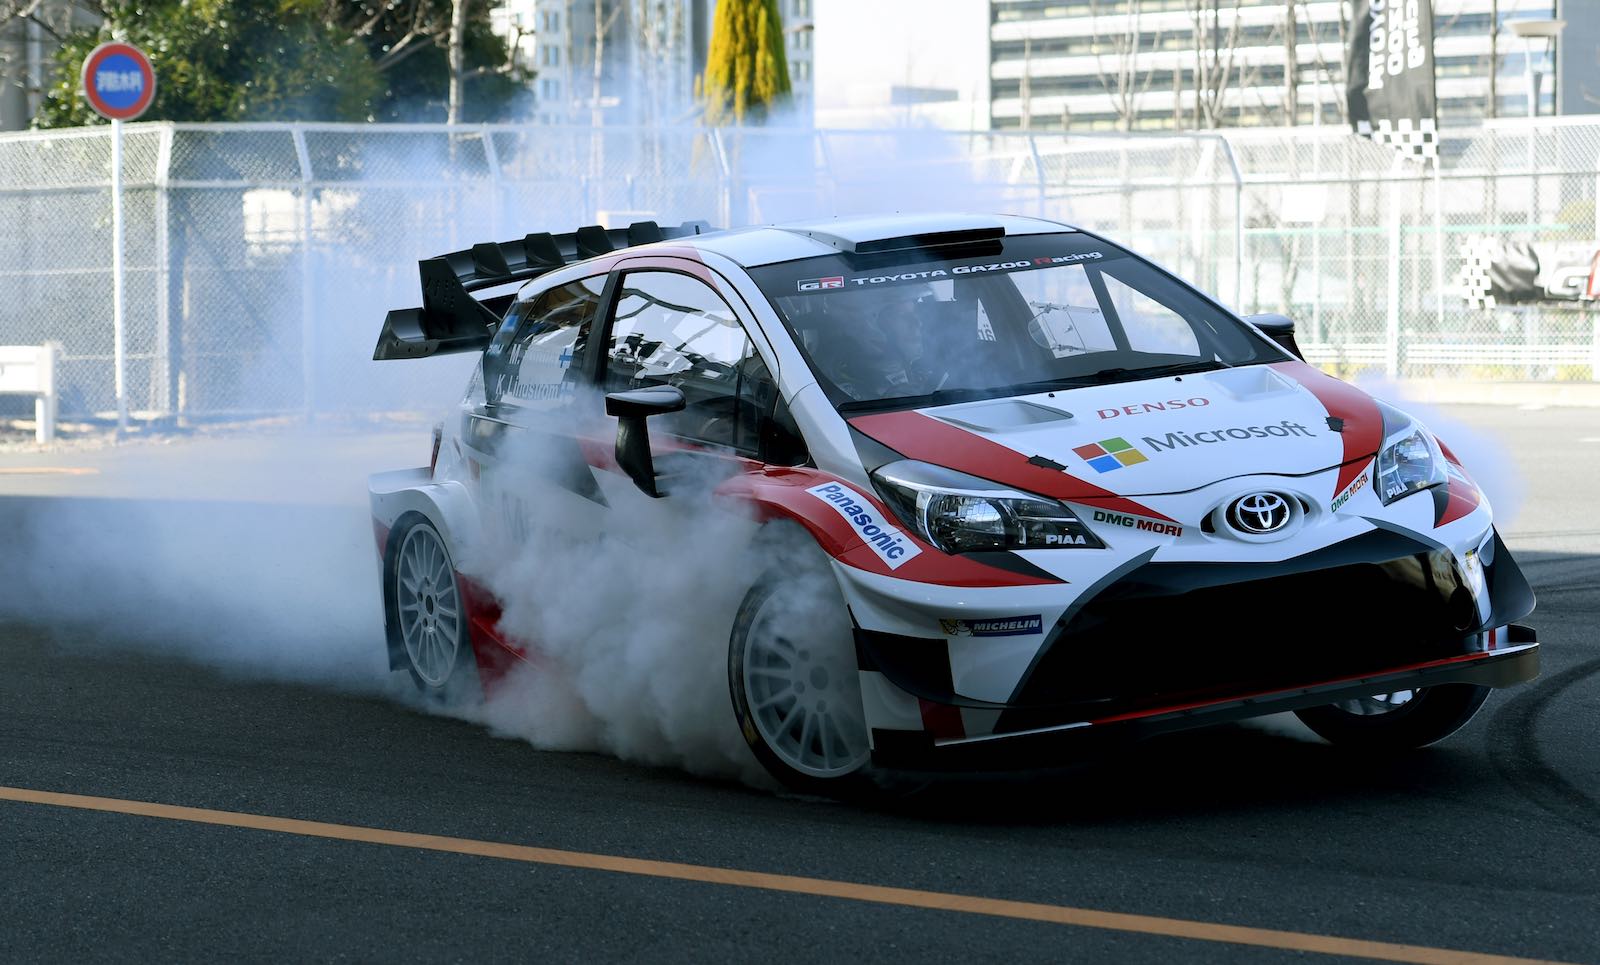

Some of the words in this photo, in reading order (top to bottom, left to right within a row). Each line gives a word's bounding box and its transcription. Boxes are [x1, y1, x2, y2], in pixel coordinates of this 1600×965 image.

[851, 269, 947, 286] TOYOTA
[952, 260, 1031, 275] GAZOO
[1034, 252, 1103, 266] Racing
[1096, 397, 1211, 420] DENSO
[1141, 420, 1317, 452] Microsoft
[1331, 491, 1350, 513] DMG
[1349, 472, 1369, 497] MORI
[1386, 480, 1409, 499] PIAA
[815, 484, 905, 560] Panasonic
[1093, 510, 1134, 528] DMG
[1136, 519, 1183, 537] MORI
[1045, 534, 1087, 545] PIAA
[973, 619, 1040, 631] MICHELIN
